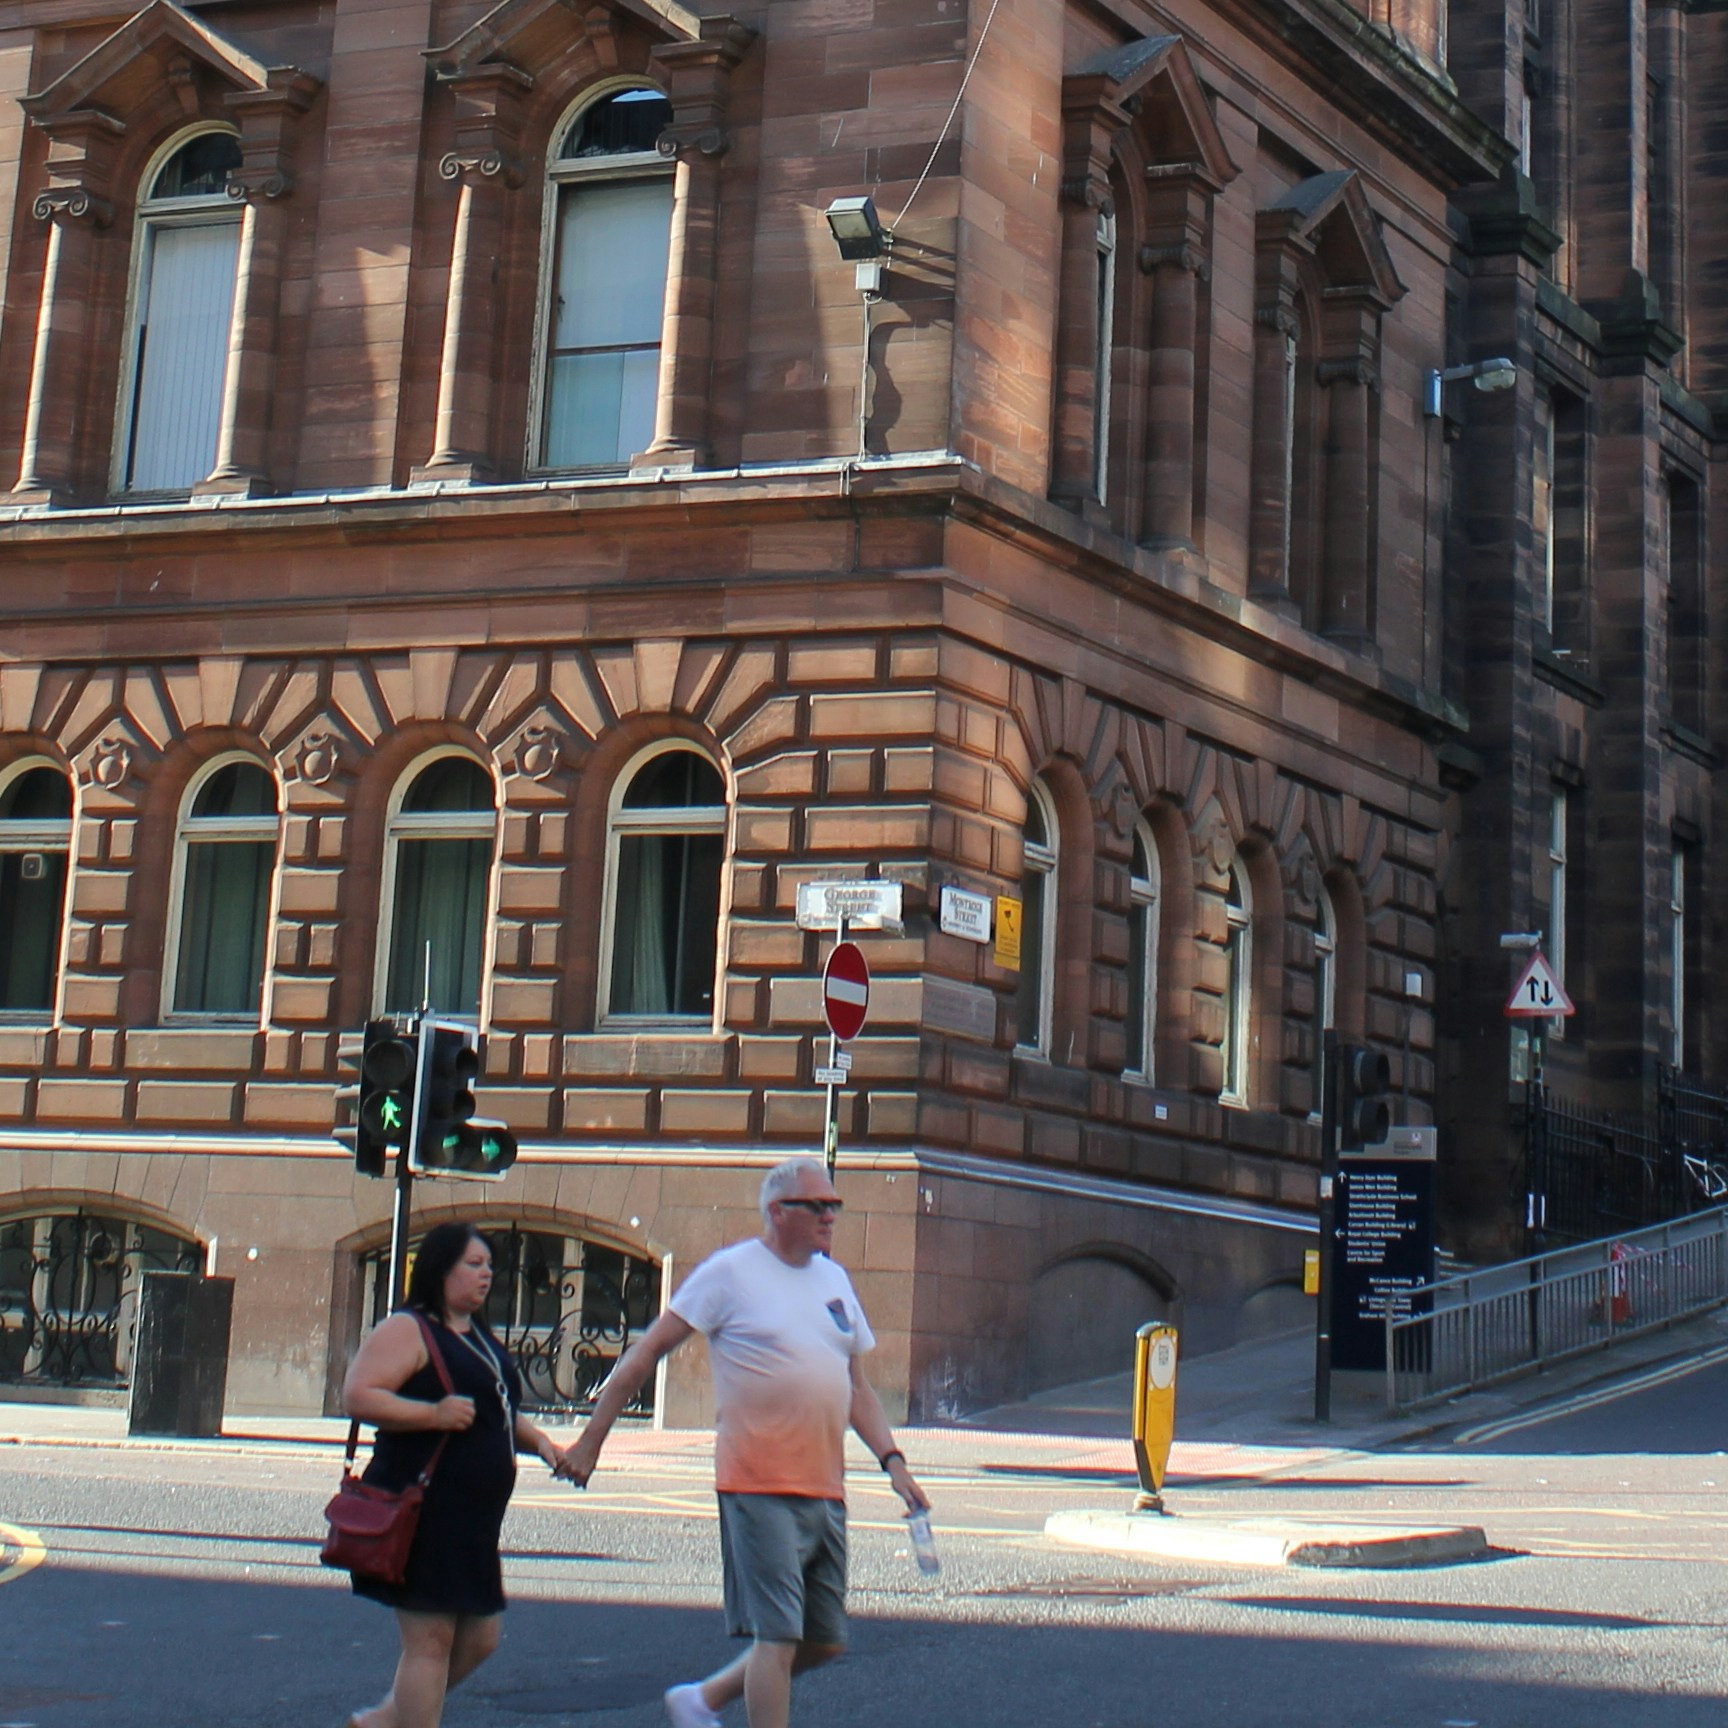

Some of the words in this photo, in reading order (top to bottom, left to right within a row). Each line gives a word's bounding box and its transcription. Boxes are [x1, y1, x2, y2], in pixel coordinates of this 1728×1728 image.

[824, 888, 876, 899] GEORGE
[949, 892, 983, 914] MONTROSE
[955, 906, 977, 925] STREET
[1377, 1174, 1397, 1182] Building
[1376, 1212, 1396, 1220] Building
[1381, 1231, 1401, 1239] Building
[1392, 1277, 1412, 1285] Building
